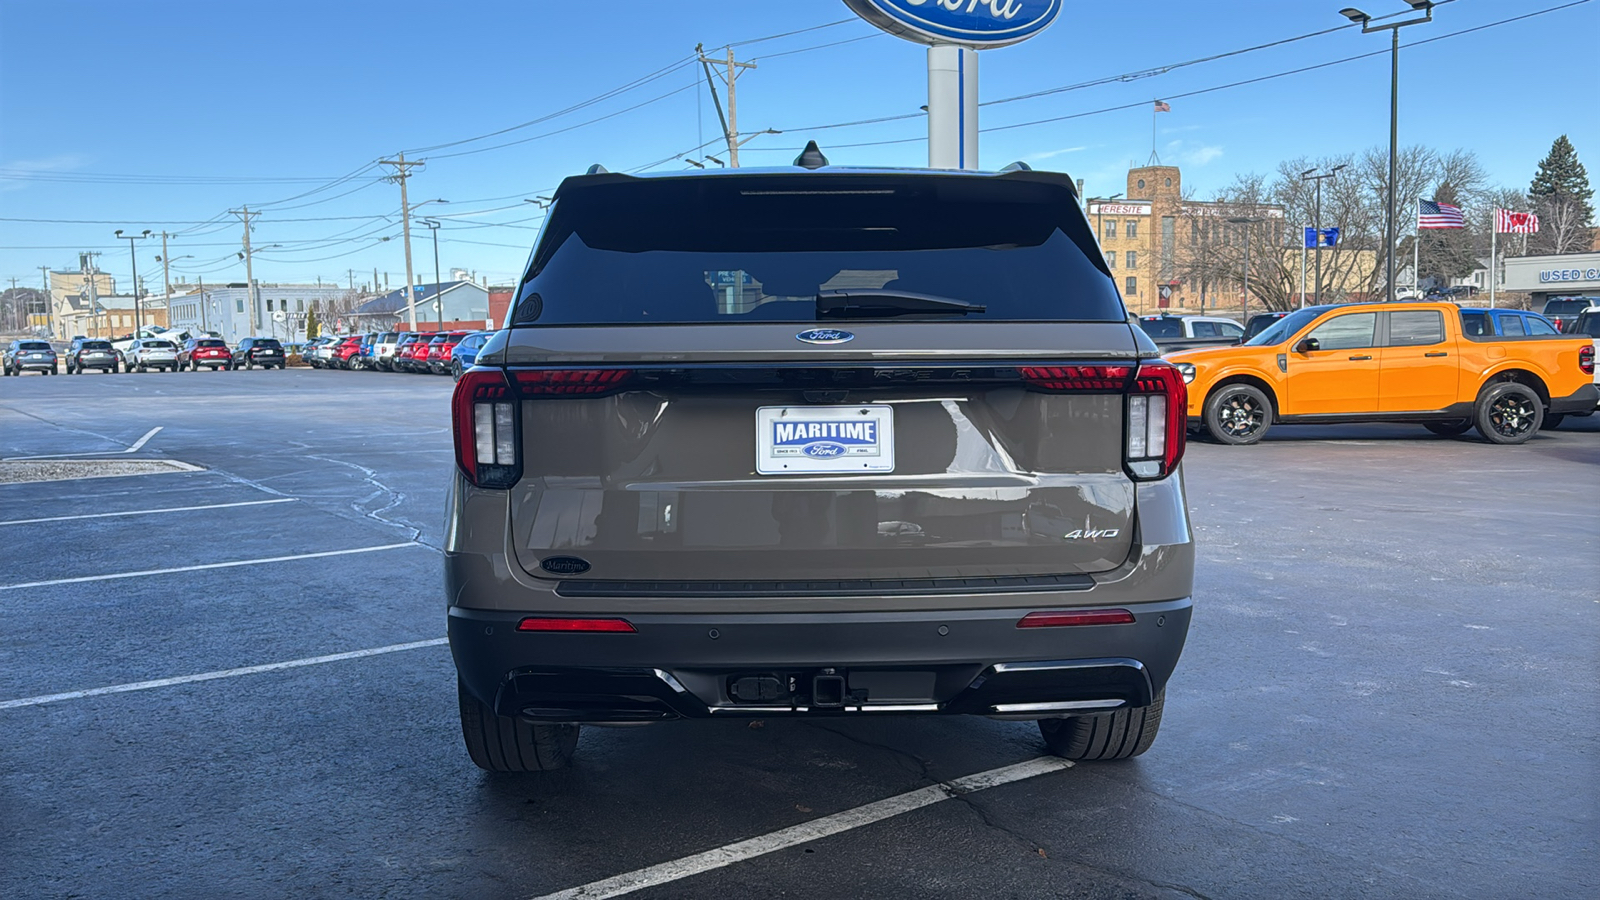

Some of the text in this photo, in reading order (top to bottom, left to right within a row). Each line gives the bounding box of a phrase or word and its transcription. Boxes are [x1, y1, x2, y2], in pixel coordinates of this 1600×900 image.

[1097, 205, 1143, 214] HERESITE
[1541, 268, 1600, 281] USED C
[809, 330, 841, 340] Ford
[776, 422, 875, 444] MARITIME
[810, 445, 838, 456] Ford
[1064, 528, 1119, 539] 4WD
[546, 560, 586, 571] Maritime
